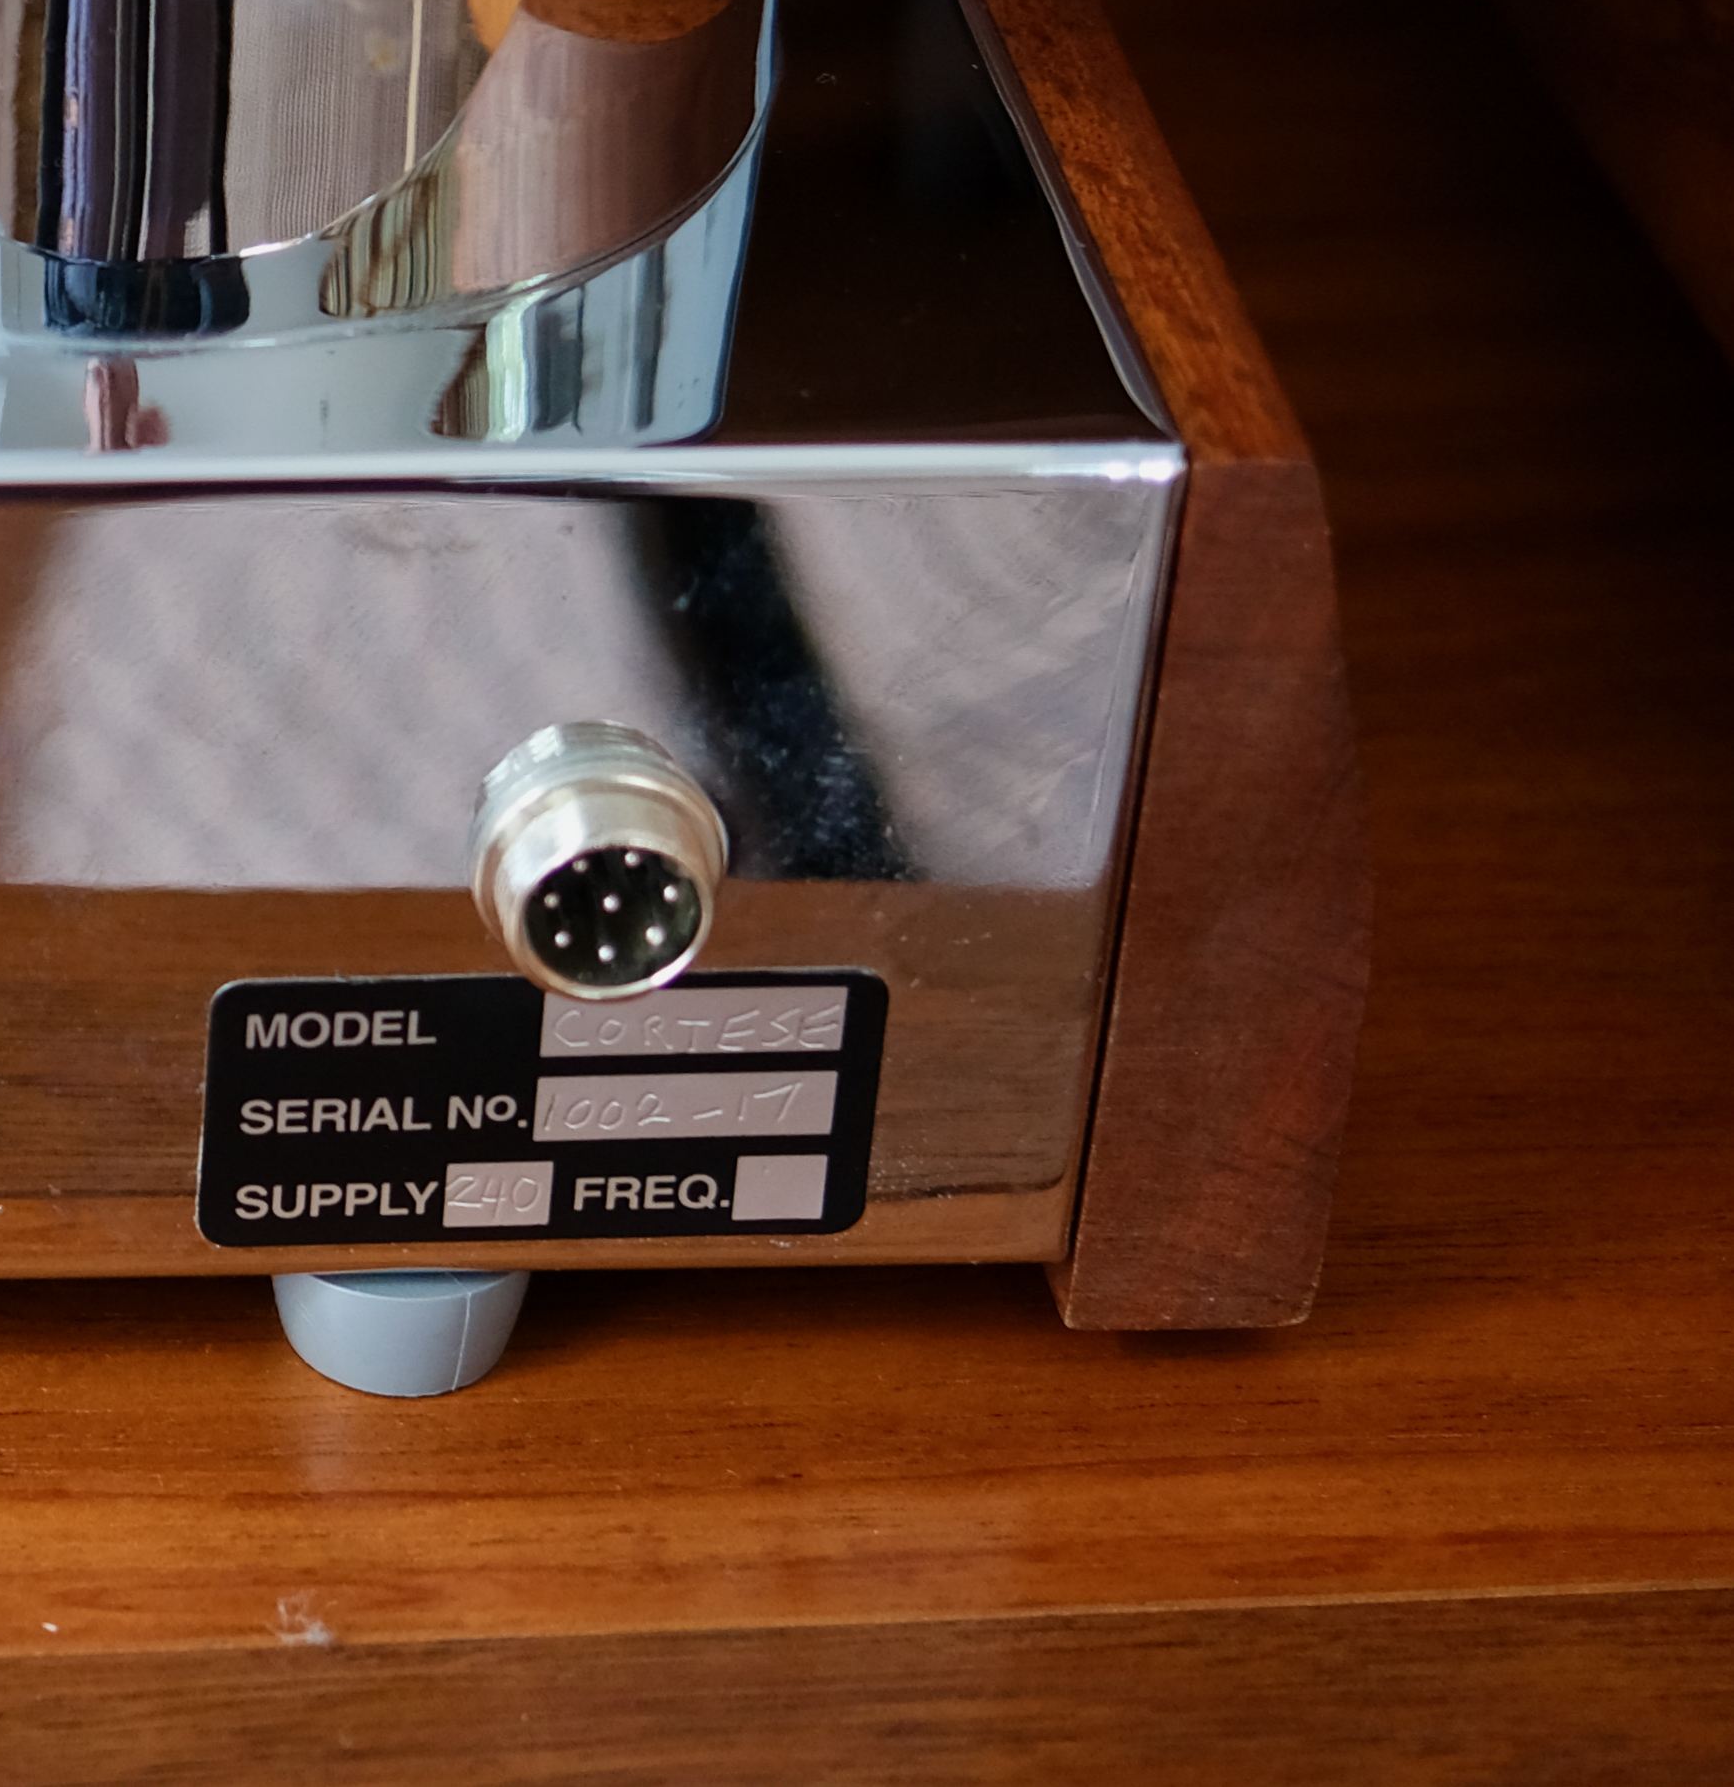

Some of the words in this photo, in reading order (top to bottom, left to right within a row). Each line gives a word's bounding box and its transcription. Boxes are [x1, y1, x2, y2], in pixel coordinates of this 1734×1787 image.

[245, 1010, 436, 1050] MODEL
[553, 1004, 841, 1051] CORTESE
[239, 1096, 432, 1135] SERIAL
[447, 1095, 528, 1130] No.
[235, 1181, 439, 1220] SUPPLY
[445, 1175, 541, 1222] 240
[573, 1174, 731, 1213] FREQ.
